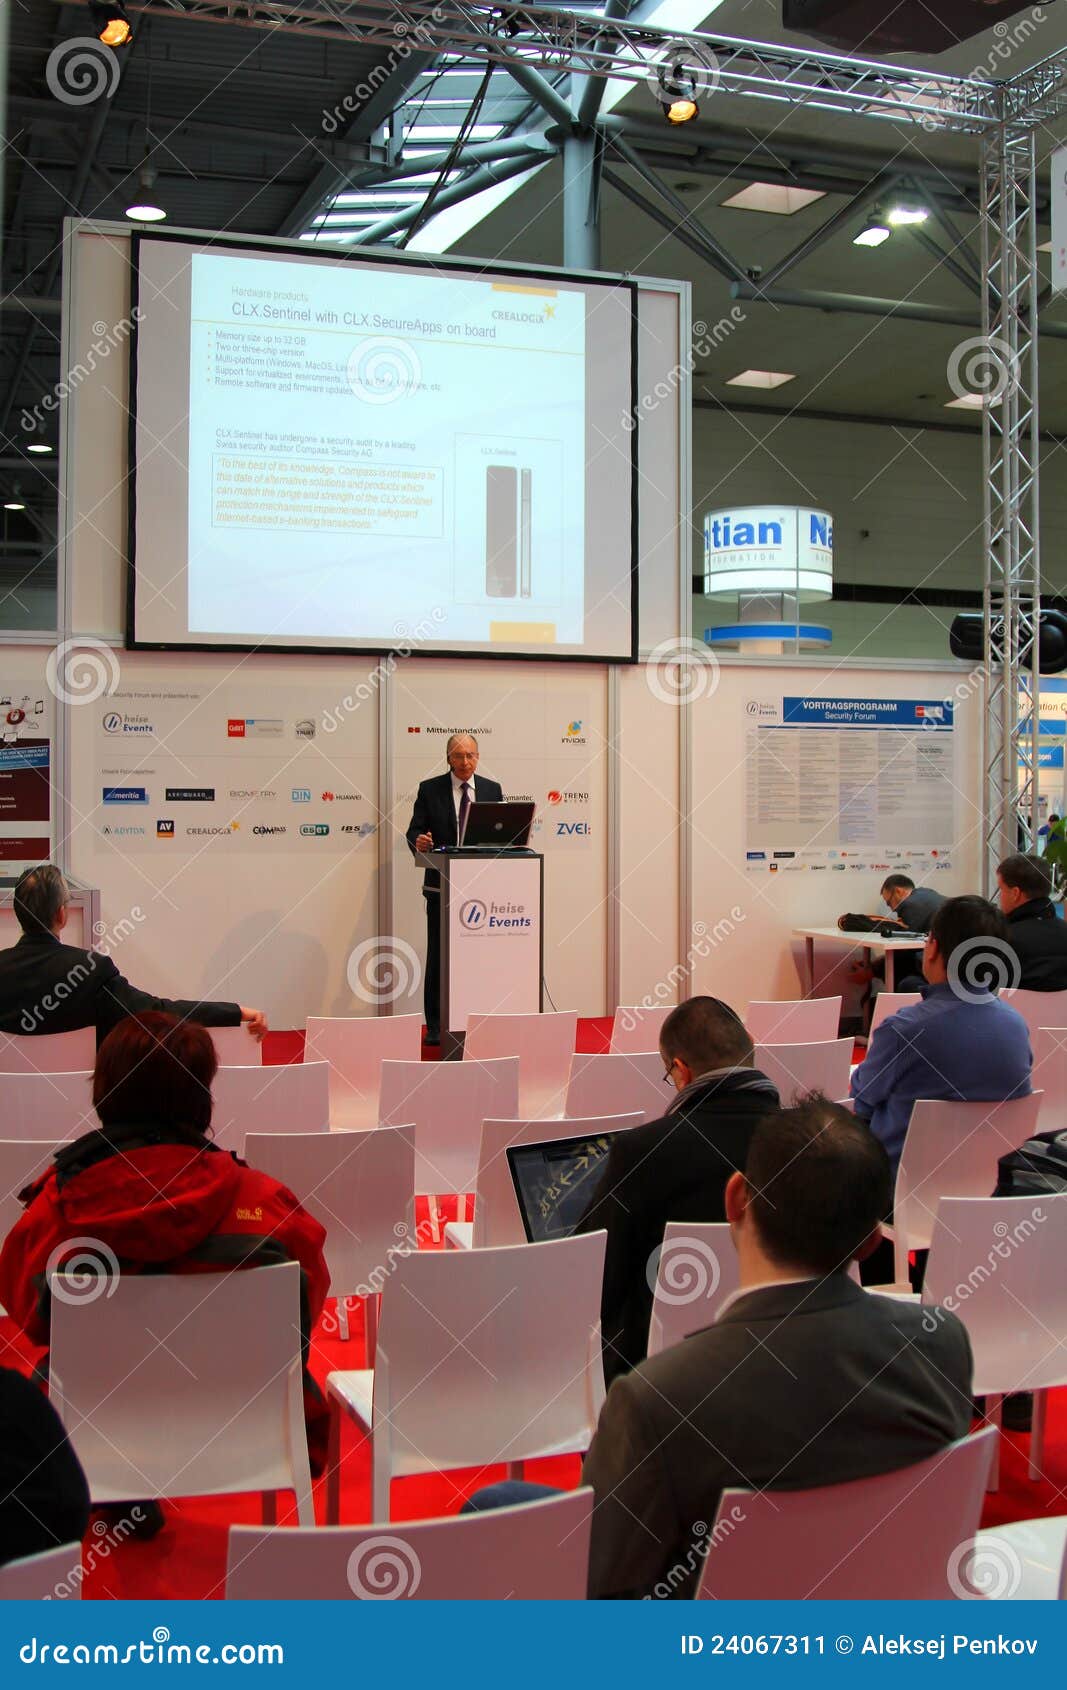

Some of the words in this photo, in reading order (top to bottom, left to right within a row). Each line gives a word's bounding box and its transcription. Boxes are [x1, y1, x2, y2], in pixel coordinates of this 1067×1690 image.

[232, 286, 272, 298] Hardware
[274, 290, 308, 302] products
[232, 302, 310, 320] CLX.Sentinel
[316, 312, 338, 324] with
[344, 312, 442, 334] CLX.SecureApps
[447, 324, 461, 334] on
[465, 325, 496, 338] board
[216, 330, 245, 342] Memory
[216, 342, 230, 351] Two
[216, 366, 244, 377] Support
[215, 377, 244, 388] Remote
[265, 432, 278, 440] has
[280, 434, 318, 444] undergone
[327, 436, 354, 447] security
[356, 438, 372, 447] audit
[374, 438, 383, 448] by
[239, 441, 270, 452] security
[296, 444, 328, 456] Compass
[803, 702, 897, 711] VORTRAGSPROGRAMM
[825, 712, 853, 721] Security
[854, 712, 876, 720] Forum
[124, 724, 152, 732] Events
[292, 791, 311, 800] DIN
[160, 822, 172, 831] AV
[490, 902, 524, 914] heise
[489, 916, 531, 928] Events
